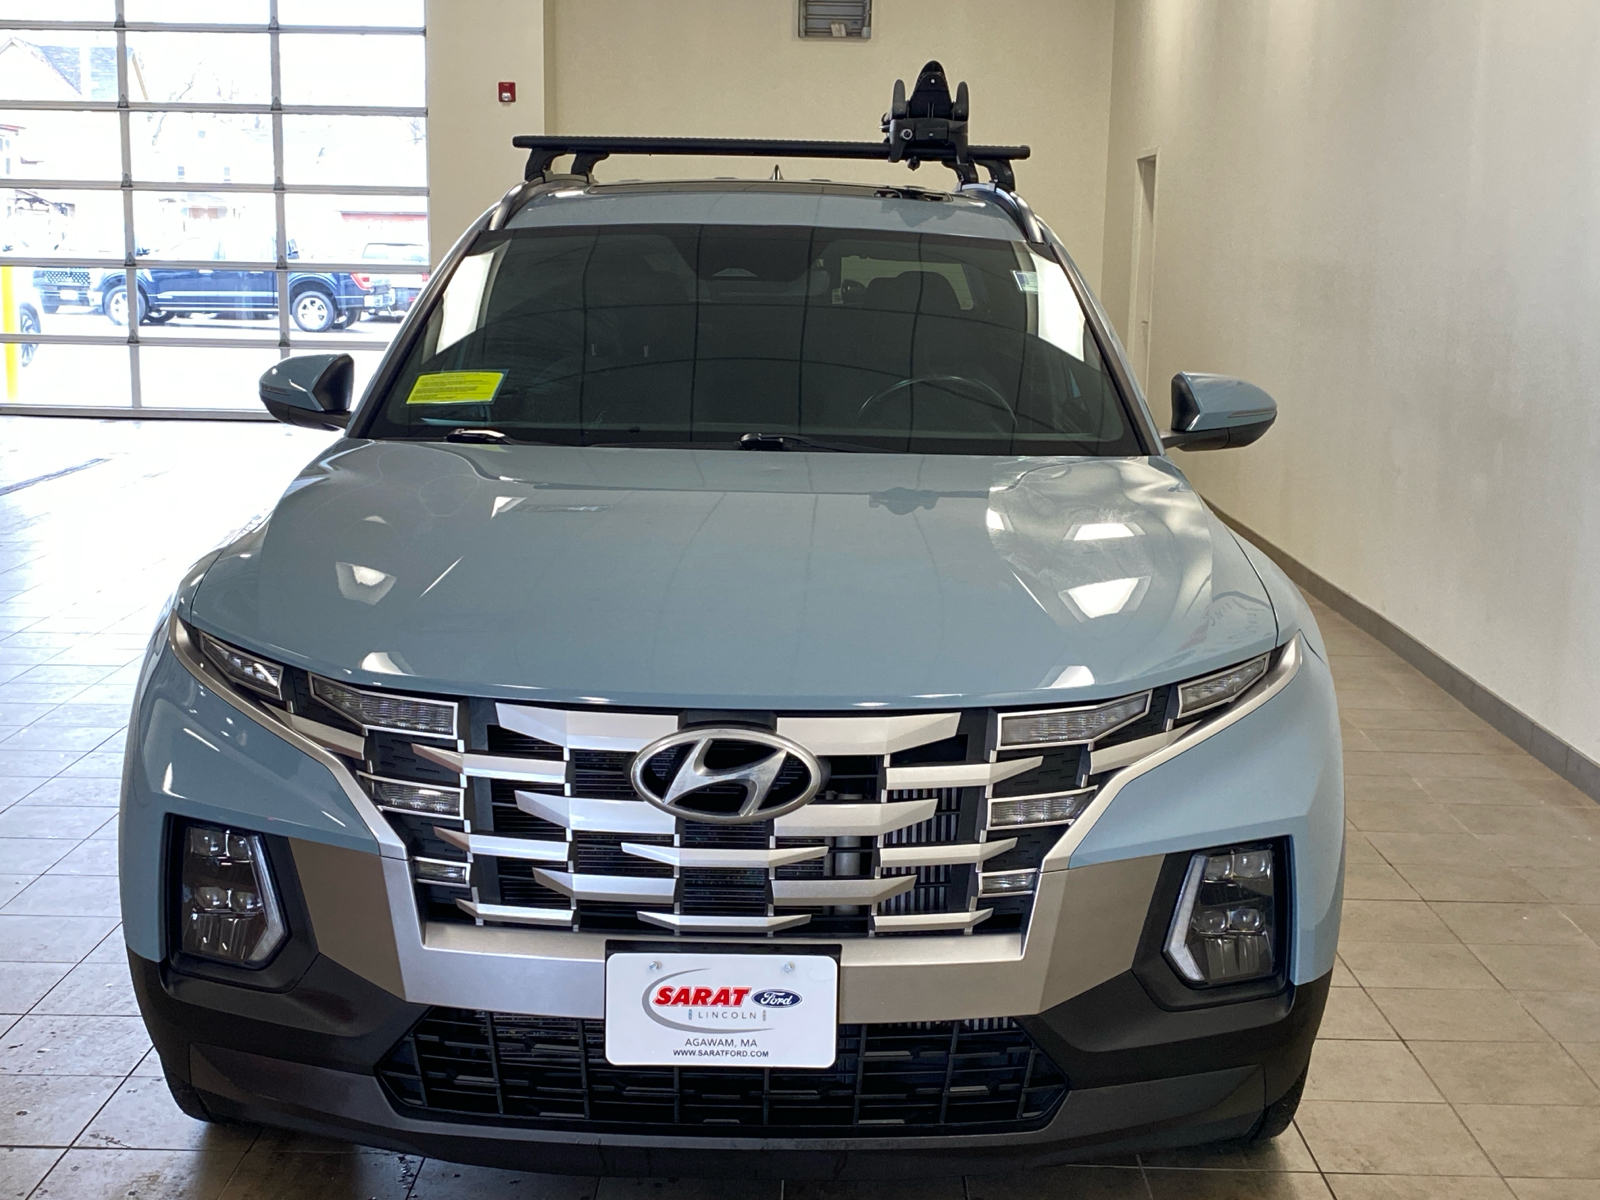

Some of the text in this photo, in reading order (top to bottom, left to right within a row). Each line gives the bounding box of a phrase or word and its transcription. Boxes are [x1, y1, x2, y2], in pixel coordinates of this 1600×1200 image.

[653, 985, 793, 1007] SARAT Ford
[698, 1011, 757, 1020] LINCOLN
[684, 1038, 758, 1048] AGAWAM, MA
[673, 1049, 769, 1058] WWW.SARATFORD.COM
